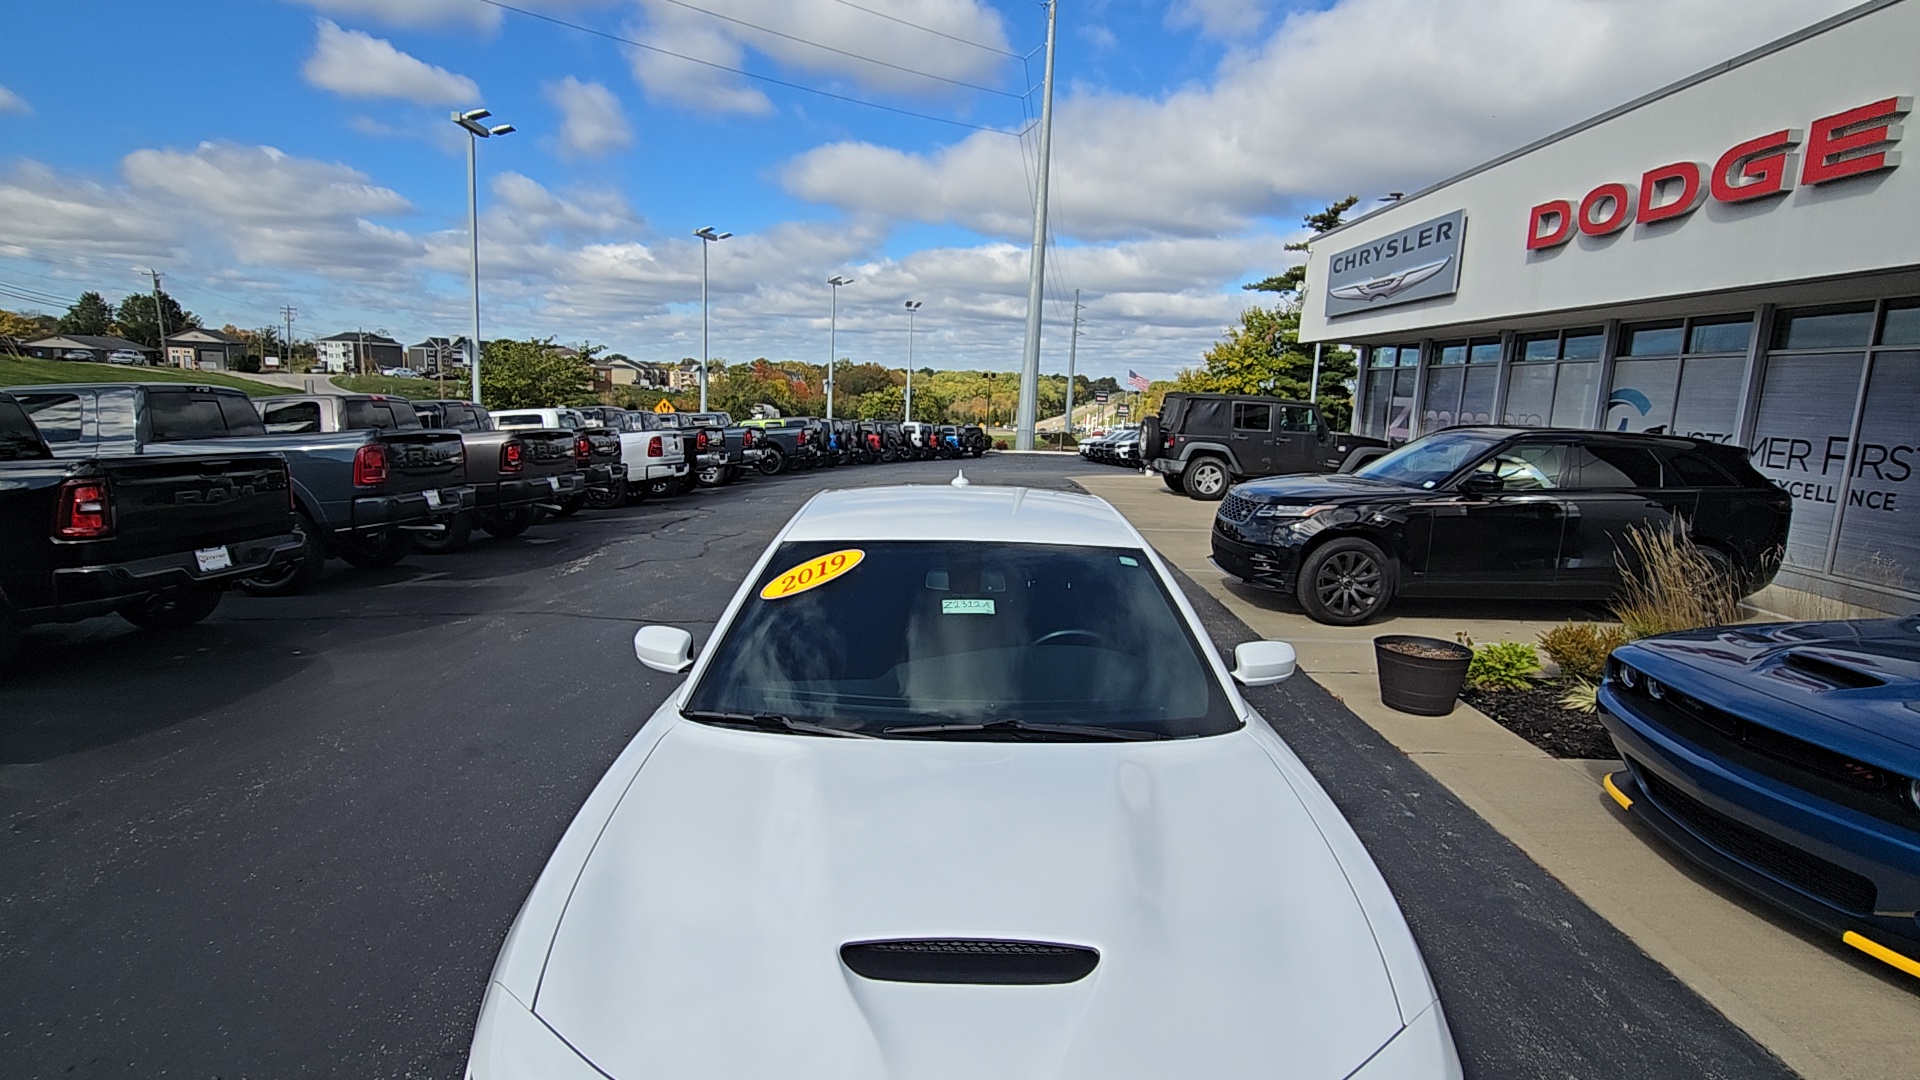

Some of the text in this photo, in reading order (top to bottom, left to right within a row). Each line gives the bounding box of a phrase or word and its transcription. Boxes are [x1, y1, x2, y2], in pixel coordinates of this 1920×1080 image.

[1526, 96, 1909, 250] DODGE
[1333, 221, 1453, 274] CHRYSLER
[1821, 436, 1920, 481] FIRS
[175, 485, 256, 503] RAM
[1769, 479, 1897, 511] XCELLNCE
[781, 554, 847, 594] 2019
